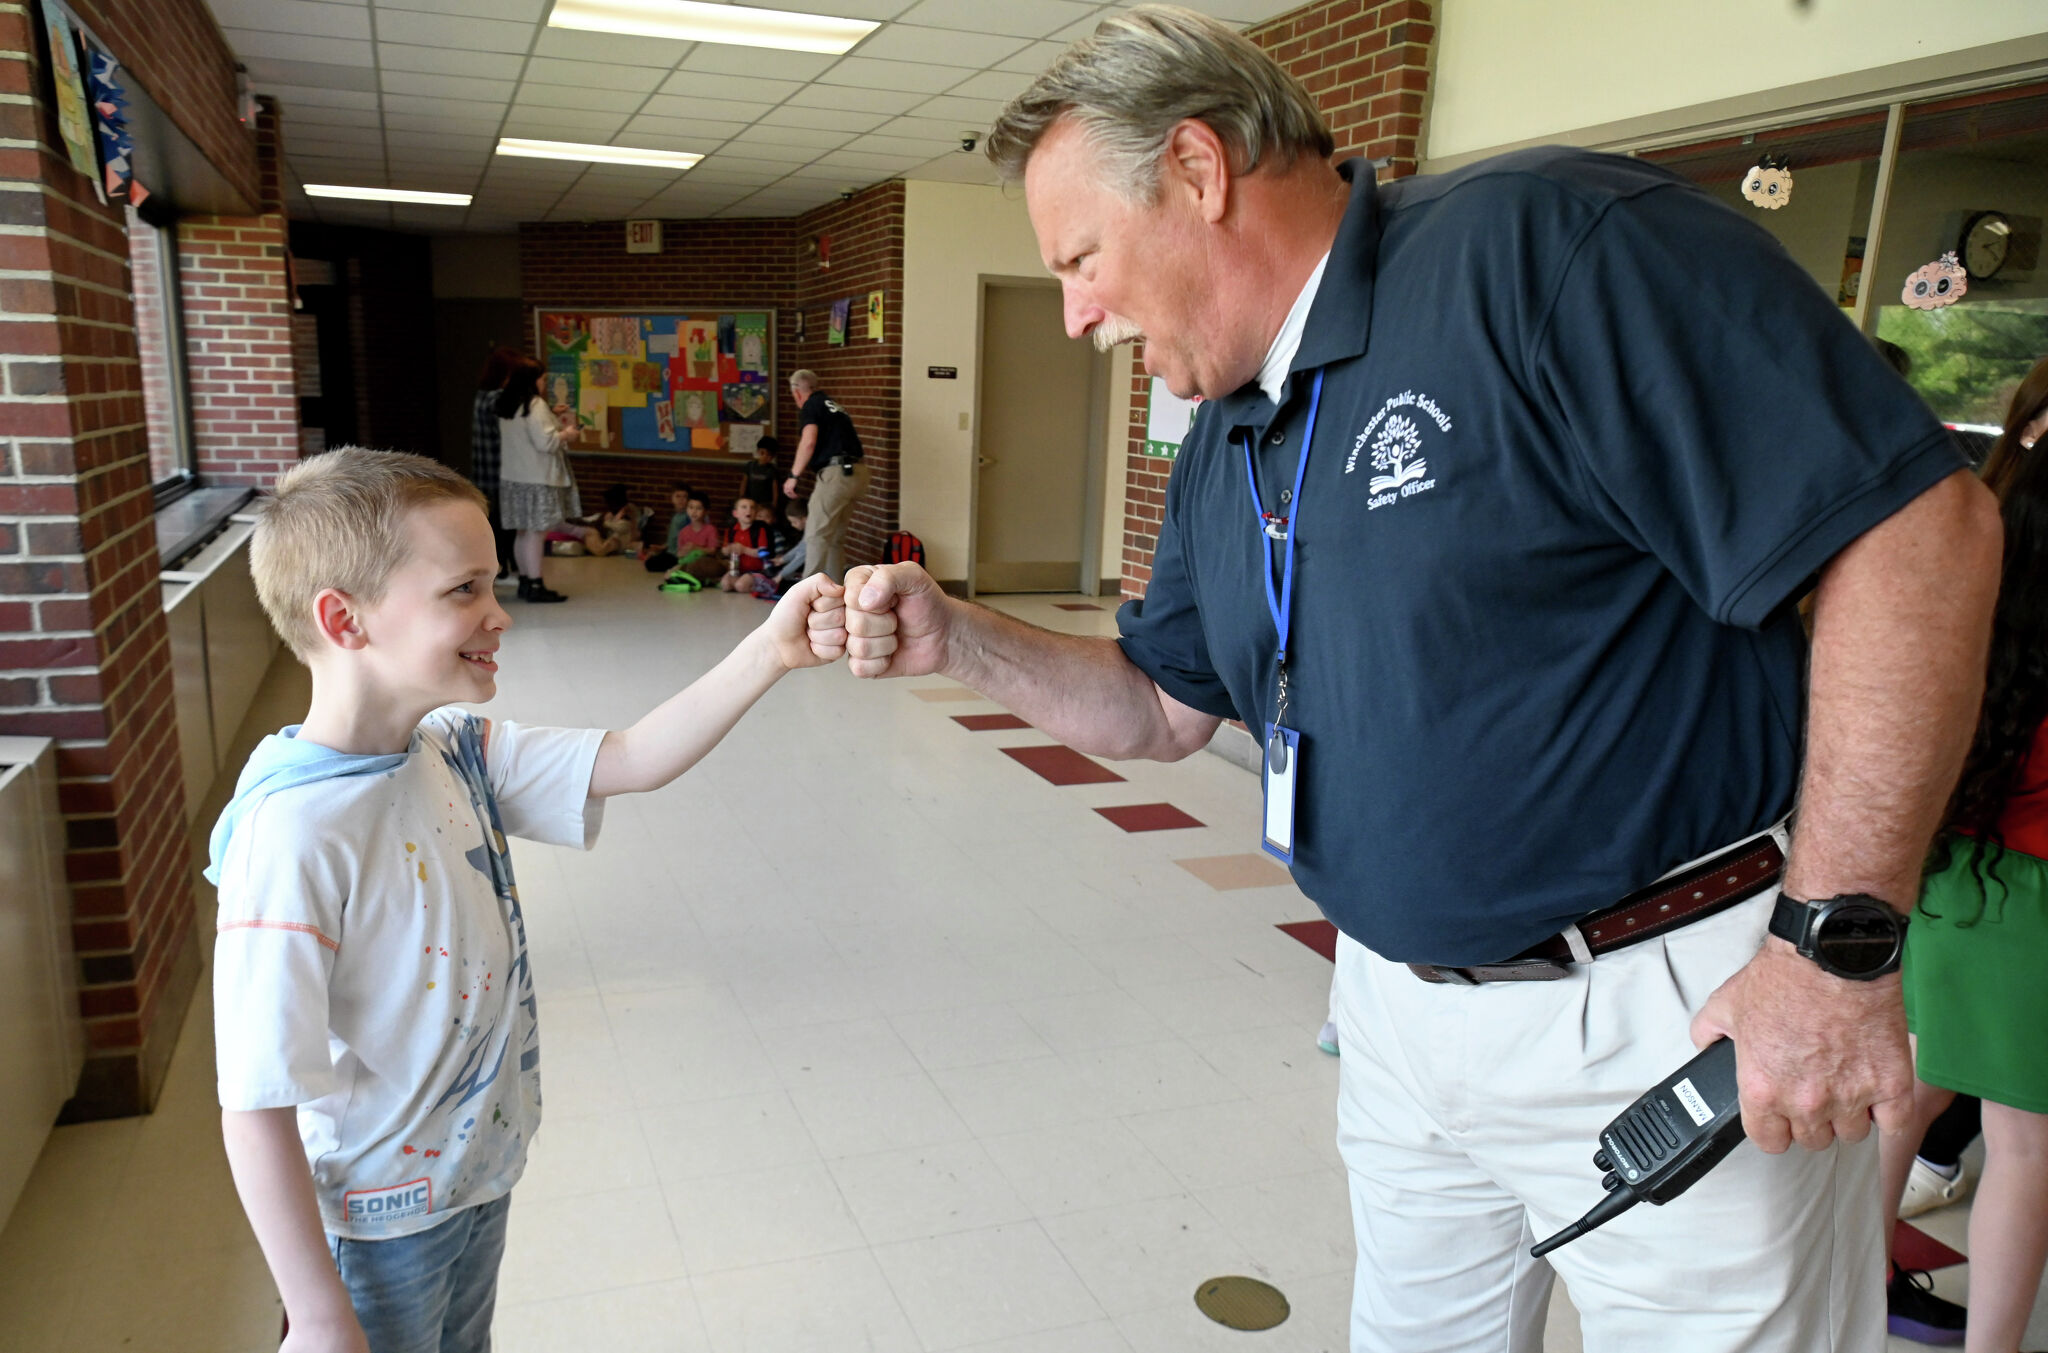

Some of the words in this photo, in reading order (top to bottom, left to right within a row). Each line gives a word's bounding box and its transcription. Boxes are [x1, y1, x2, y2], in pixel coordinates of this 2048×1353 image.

[632, 222, 653, 244] EXIT
[1345, 406, 1386, 474] Winchester
[1386, 389, 1416, 411] Public
[1416, 393, 1453, 432] Schools
[1367, 492, 1398, 510] Safety
[1401, 479, 1436, 498] Officer
[1680, 1084, 1709, 1121] MANSON
[1604, 1133, 1630, 1169] MOTOROLA
[348, 1186, 428, 1214] SONIC
